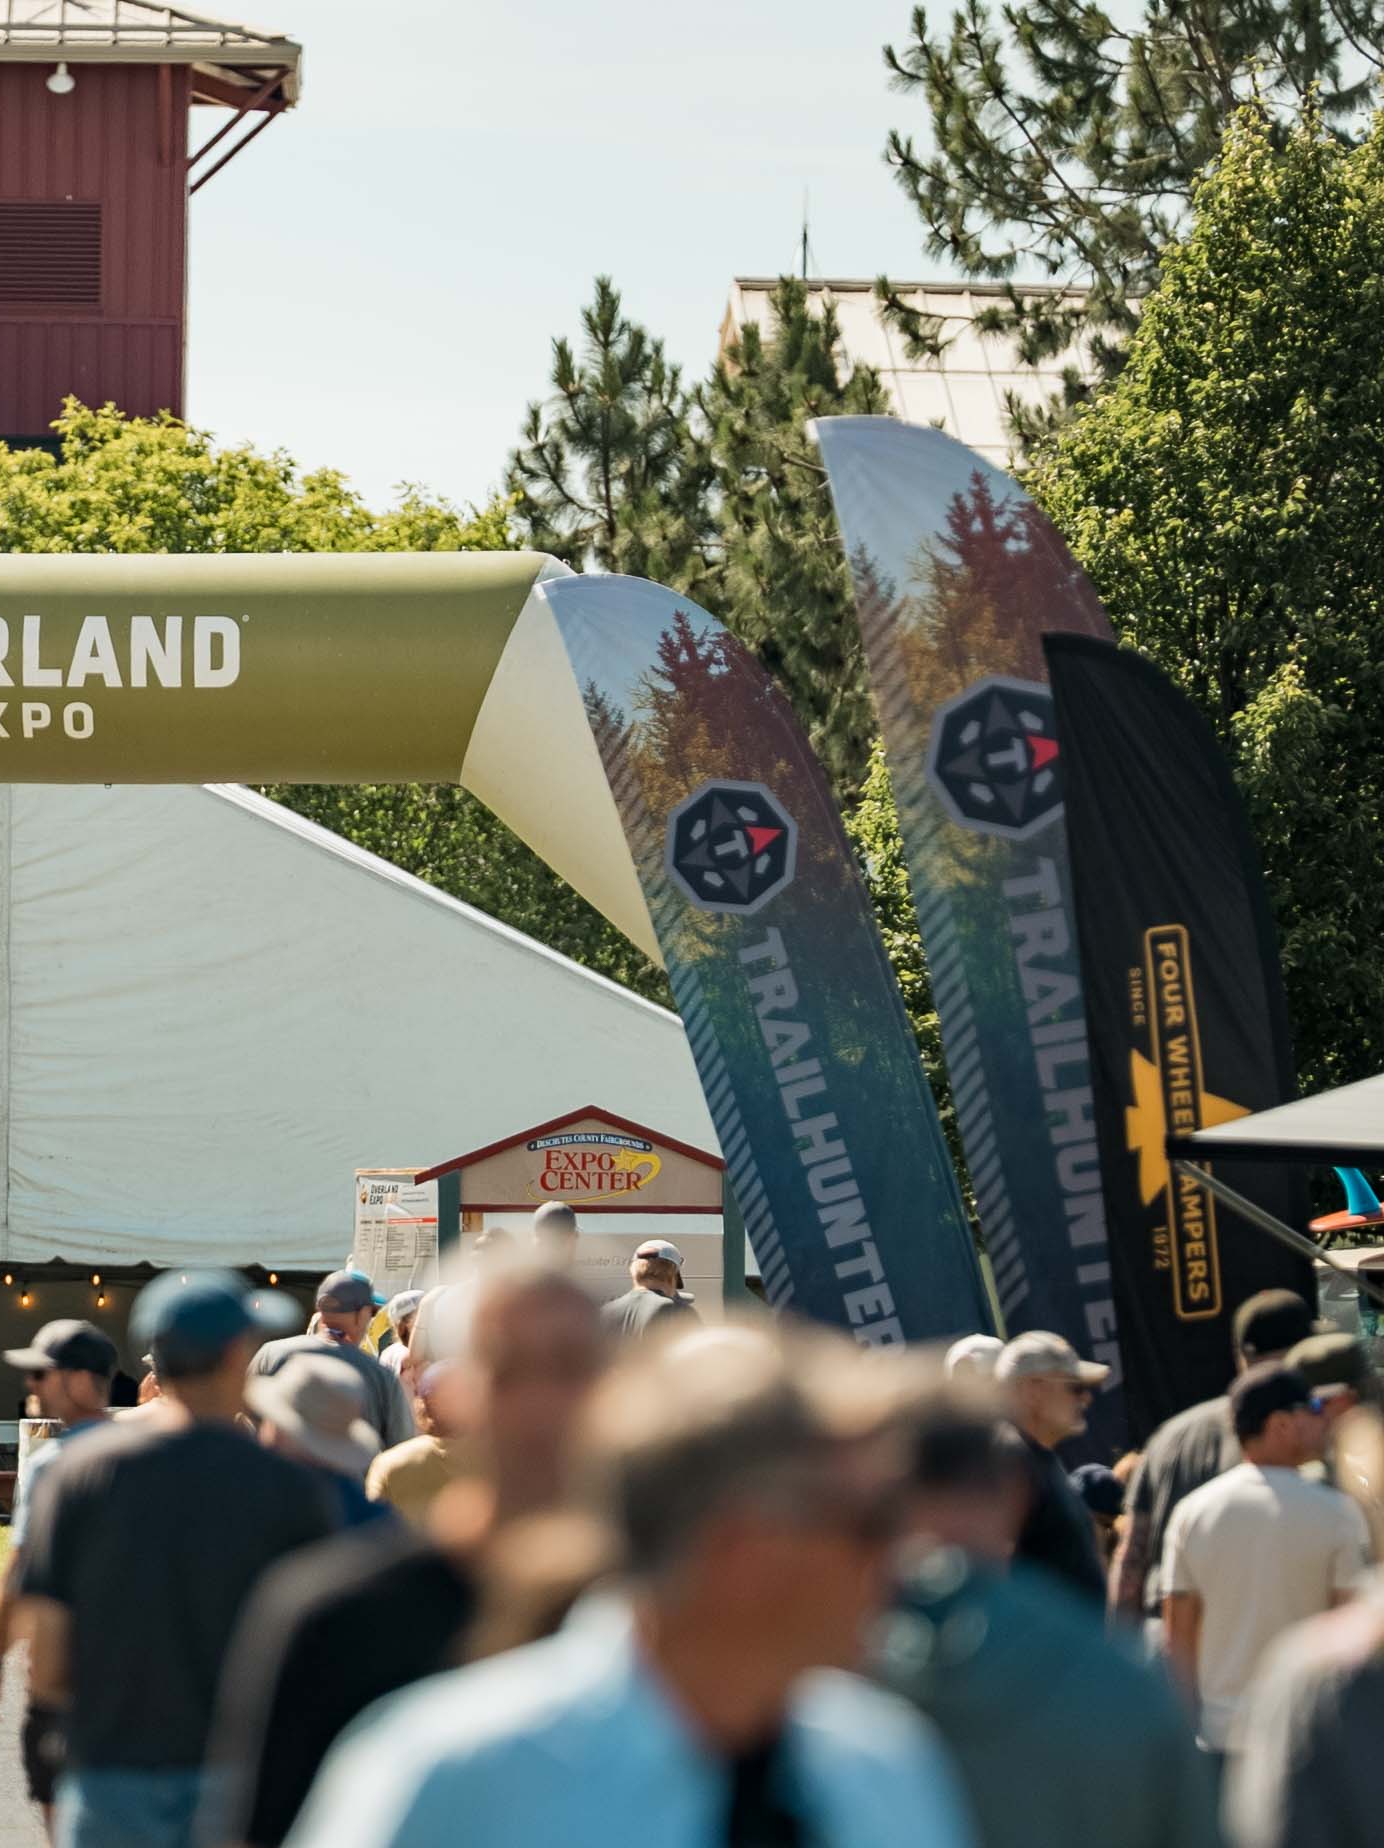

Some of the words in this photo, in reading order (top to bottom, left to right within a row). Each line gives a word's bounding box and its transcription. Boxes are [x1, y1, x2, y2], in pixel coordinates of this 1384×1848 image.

[1128, 966, 1147, 1028] SINCE
[1157, 941, 1187, 1027] FOUR
[1177, 1164, 1211, 1302] AMPERS
[539, 1170, 643, 1193] CENTER
[545, 1149, 615, 1171] EXPO
[1151, 1226, 1172, 1270] 1972
